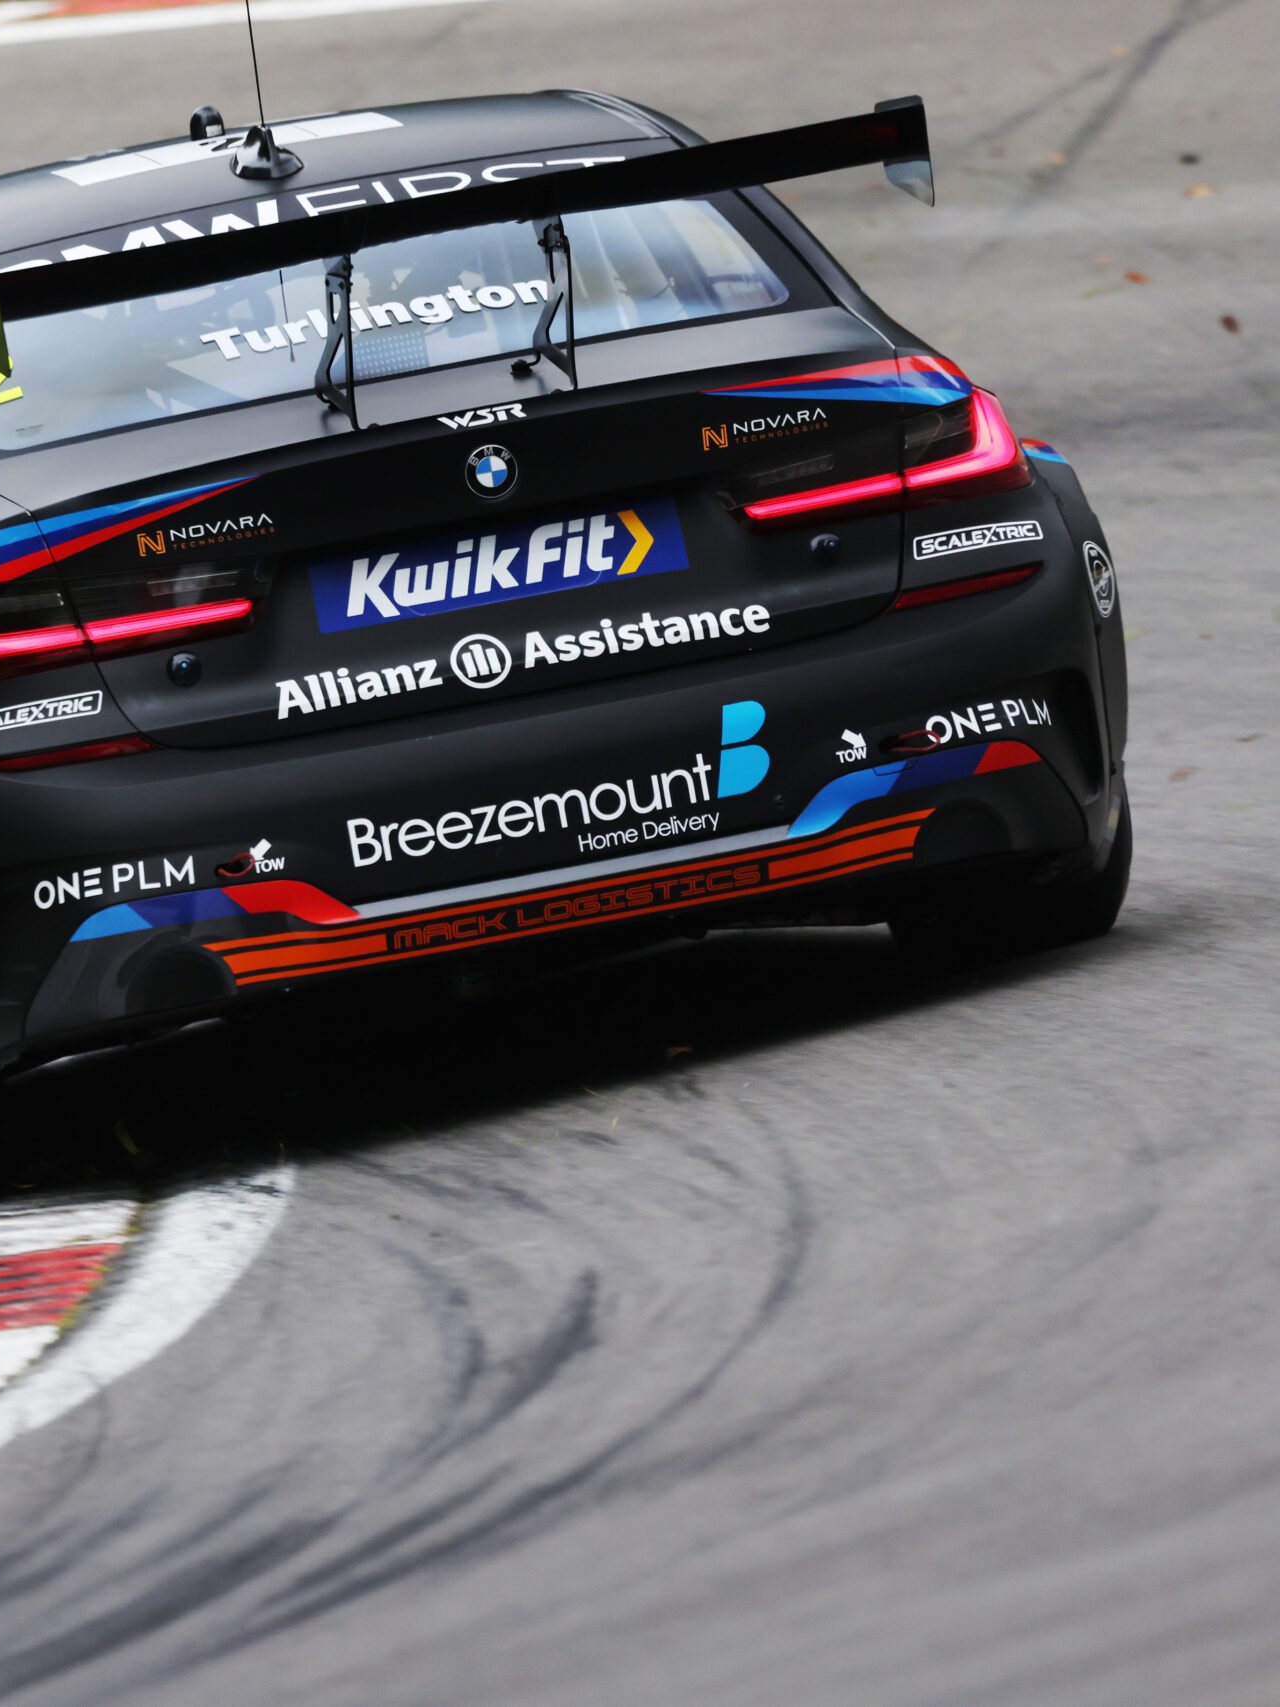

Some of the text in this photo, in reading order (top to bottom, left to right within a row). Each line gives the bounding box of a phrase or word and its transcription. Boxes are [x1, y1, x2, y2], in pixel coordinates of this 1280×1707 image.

[436, 402, 528, 430] WSR
[733, 407, 827, 435] NOVARA
[734, 421, 830, 444] TECHNOLOGIES
[467, 446, 512, 467] BMW
[170, 513, 273, 541] NOVARA
[172, 526, 277, 550] TECHNOLOGIES
[921, 524, 1037, 555] SCALEXTRIC
[275, 603, 771, 720] Allianz Assistance
[836, 746, 867, 764] TOW
[1001, 698, 1052, 727] PLM
[346, 752, 712, 869] Breezemount
[578, 812, 720, 854] Home Delivery
[34, 855, 286, 910] ONE PLM TOW
[393, 864, 762, 951] MACK LOGISTICS
